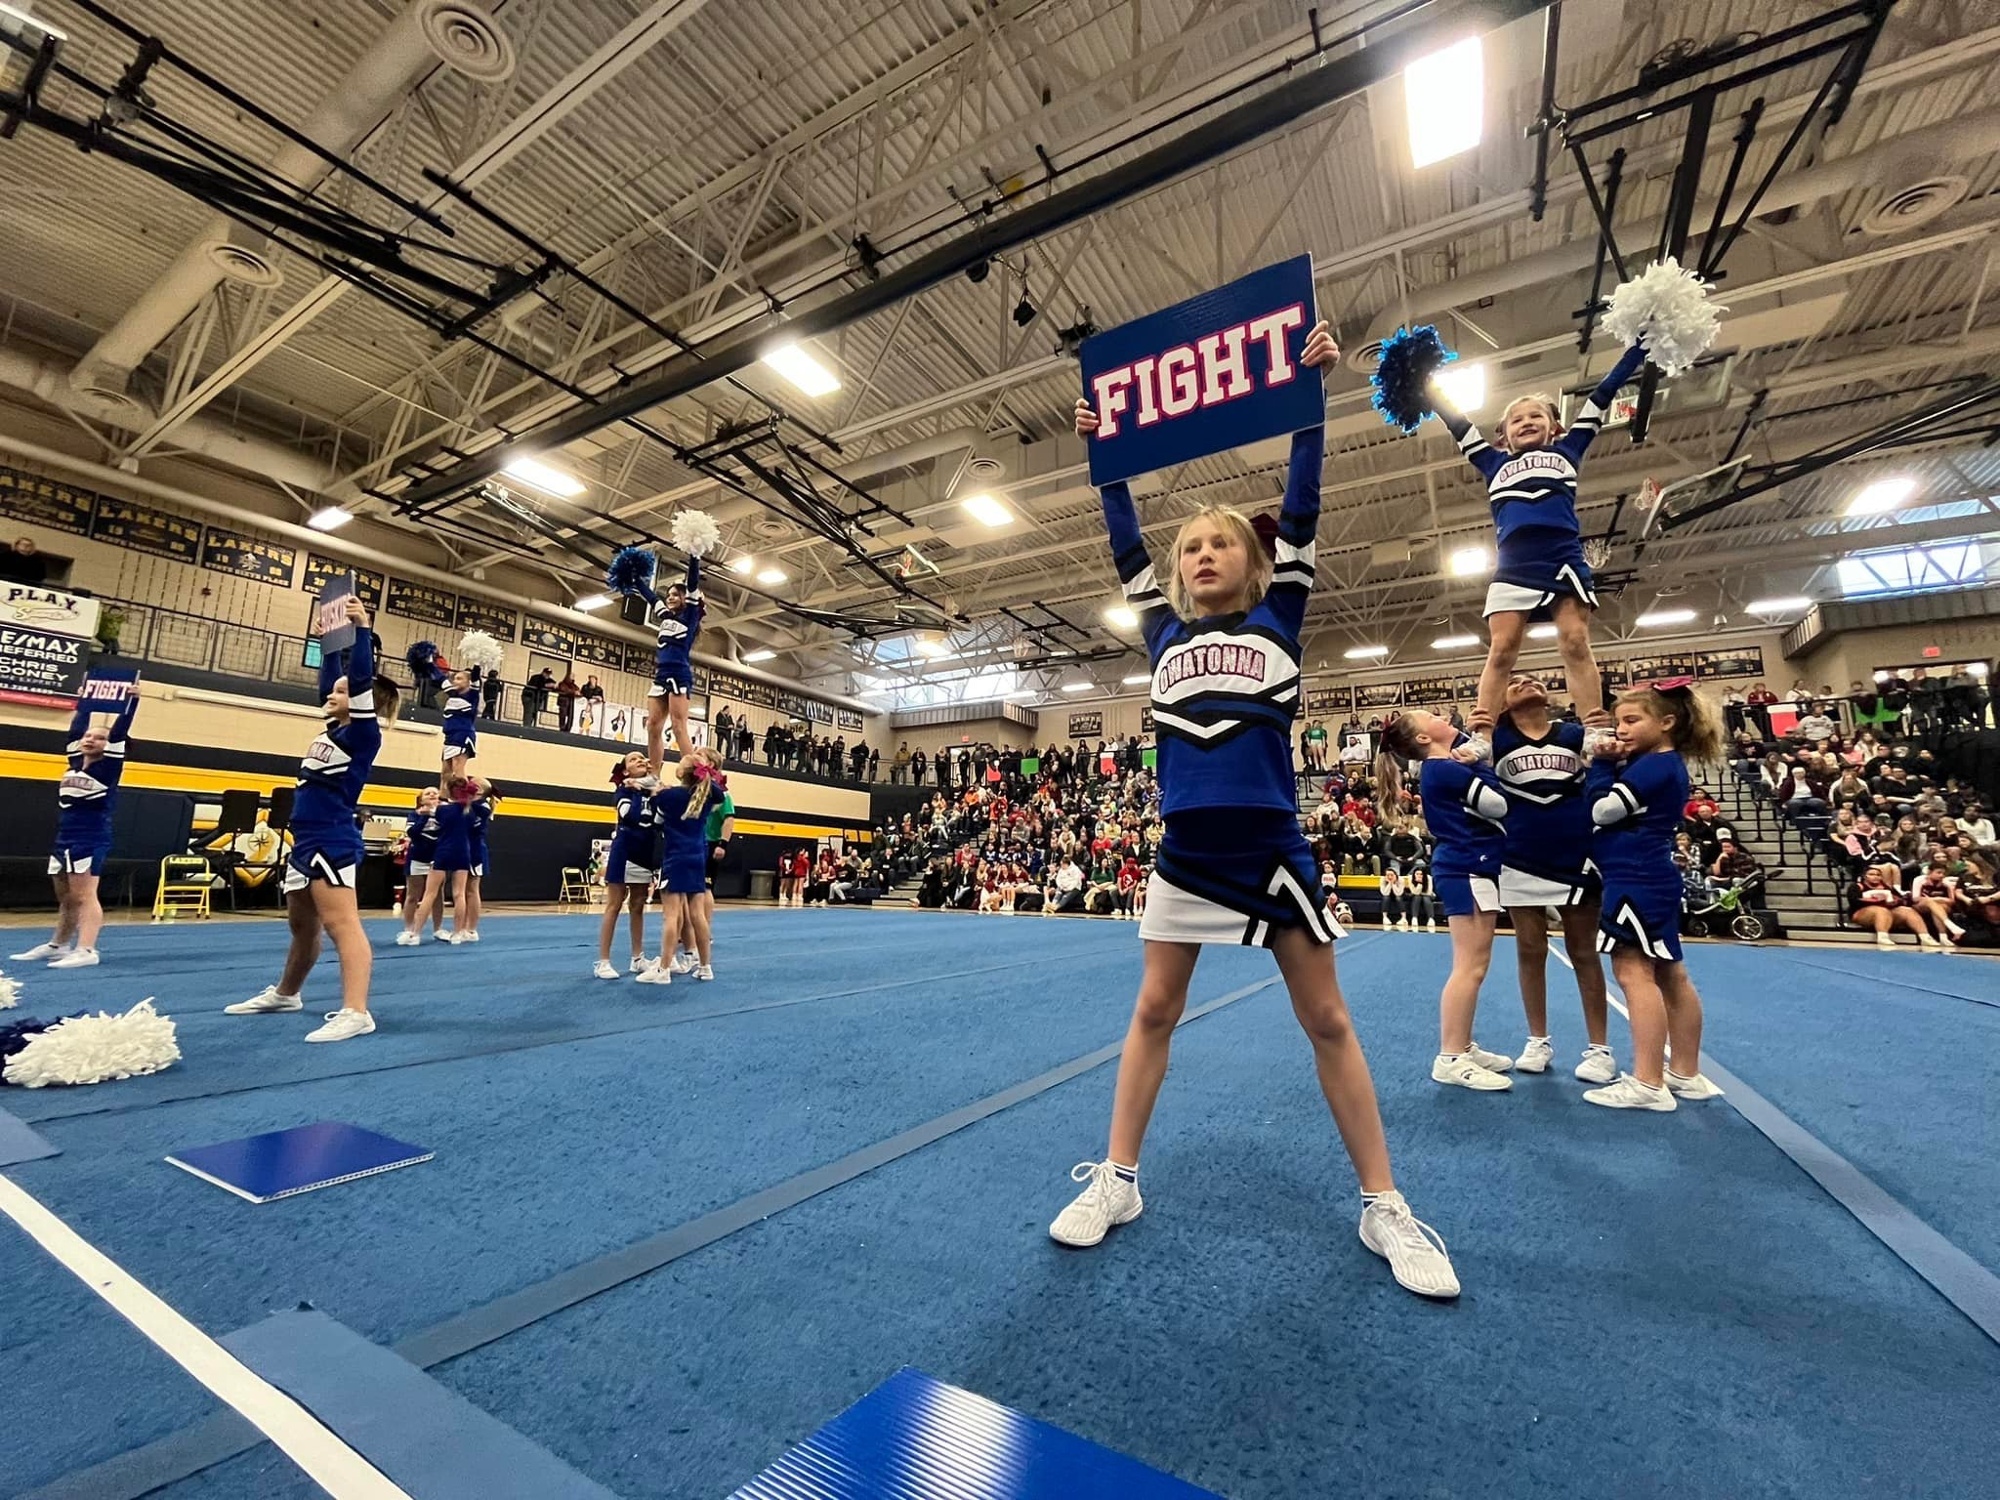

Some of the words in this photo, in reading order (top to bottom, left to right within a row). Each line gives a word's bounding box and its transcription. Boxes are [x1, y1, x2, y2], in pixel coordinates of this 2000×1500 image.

[1091, 301, 1305, 441] FIGHT
[1499, 454, 1567, 483] OWATONNA
[98, 505, 199, 543] LAKERS
[207, 536, 293, 568] LAKERS
[308, 561, 381, 591] LAKRS
[389, 584, 454, 610] LAKERS
[459, 603, 516, 626] LAKERS
[525, 619, 575, 643] LAKERS
[0, 644, 78, 664] EFERRED
[577, 636, 623, 656] LAKERS
[0, 656, 59, 673] CHRIS
[1158, 642, 1266, 694] OWATONNA
[83, 680, 132, 700] FIGHT
[1506, 753, 1578, 777] OWATONNA
